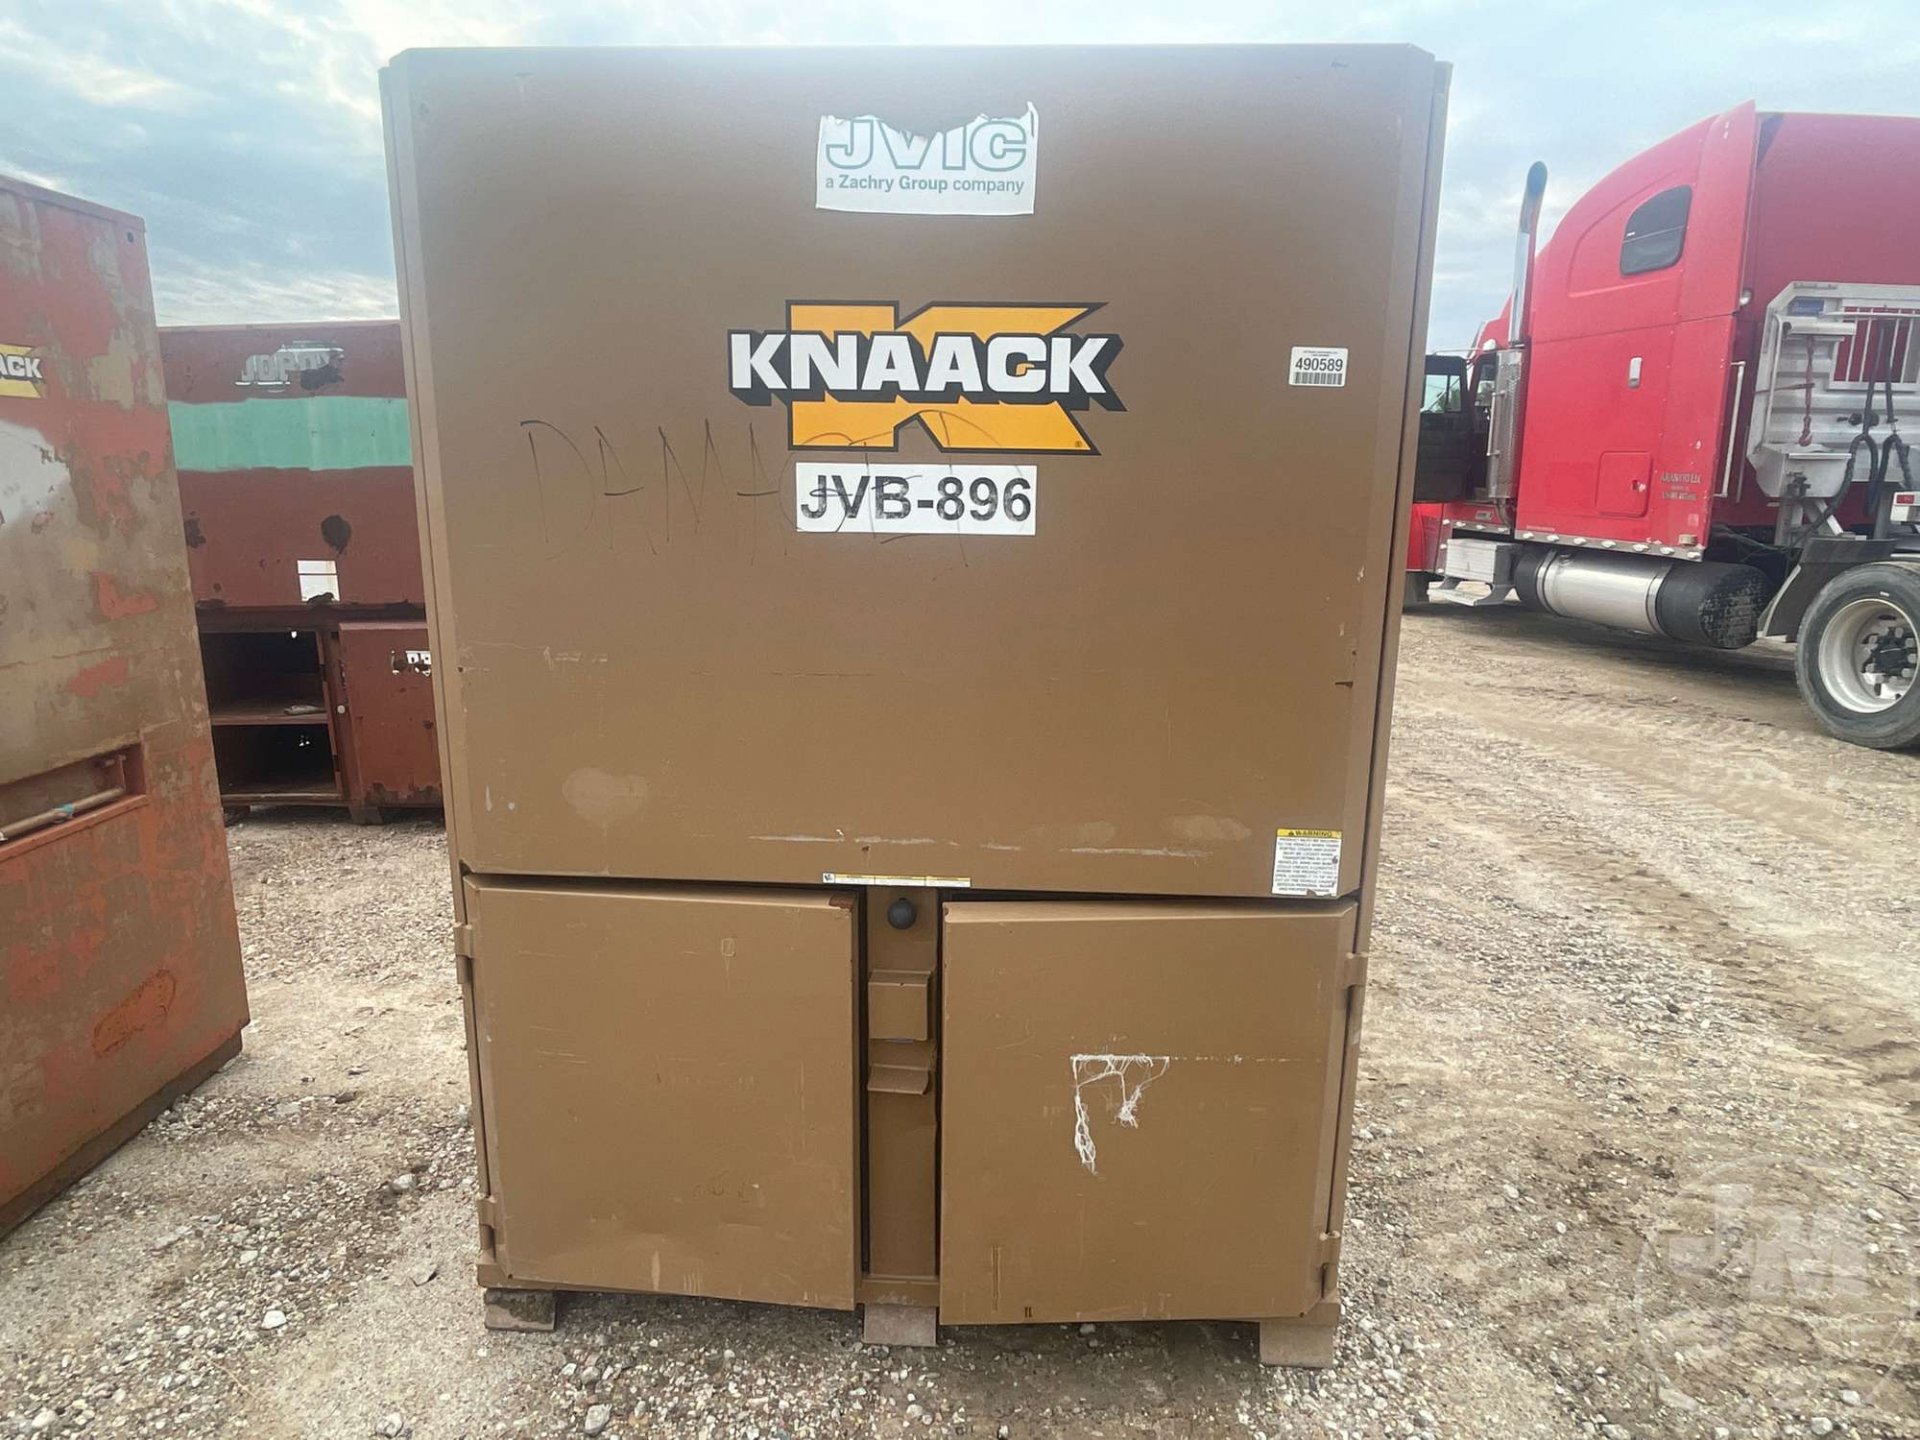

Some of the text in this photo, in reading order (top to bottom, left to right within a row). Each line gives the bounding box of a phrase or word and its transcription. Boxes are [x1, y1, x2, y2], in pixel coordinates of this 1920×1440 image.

[825, 174, 1025, 195] a Zachry Group company
[728, 331, 1112, 399] KNAACK
[1295, 357, 1344, 372] 490589
[800, 474, 1032, 522] JVB-896
